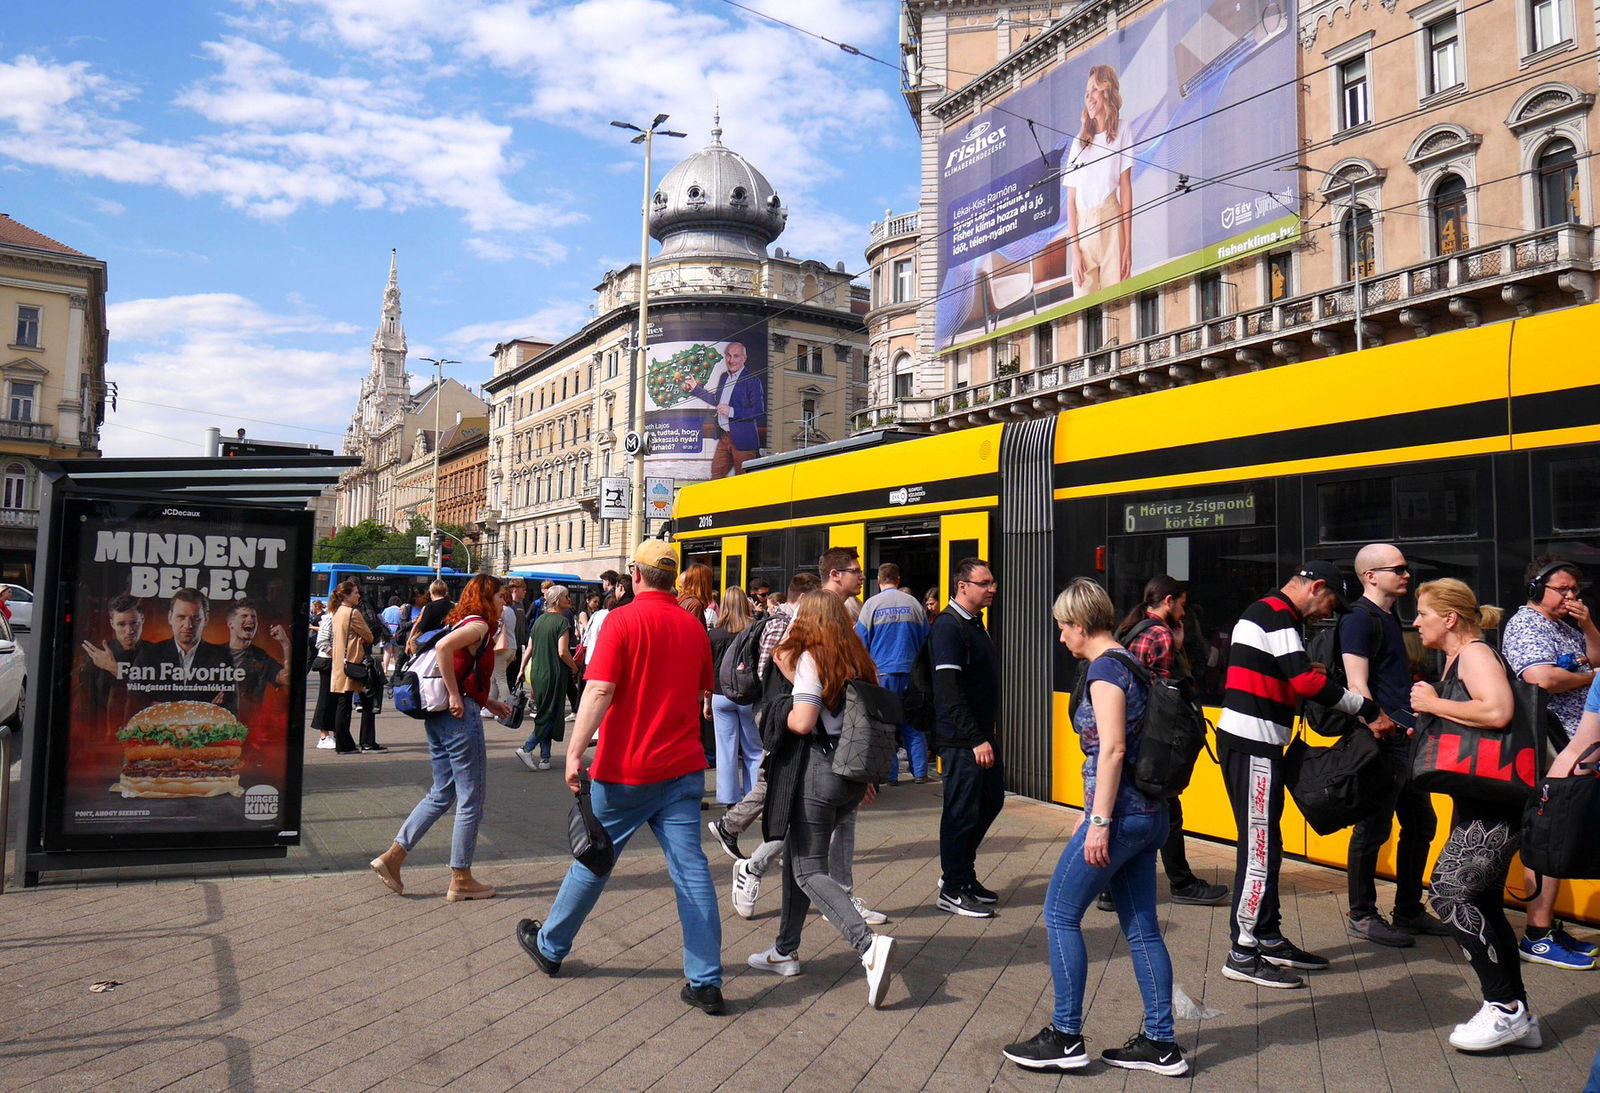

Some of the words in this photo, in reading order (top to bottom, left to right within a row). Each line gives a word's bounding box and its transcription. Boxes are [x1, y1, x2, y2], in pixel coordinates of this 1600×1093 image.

[944, 126, 1007, 170] Fisher
[944, 140, 1007, 179] KLÍMABERENDEZÉSEK
[953, 198, 987, 220] Lékai-Kiss
[987, 183, 1017, 205] Ramóna
[1235, 206, 1242, 216] 6
[1241, 202, 1252, 213] ÉV
[953, 230, 974, 244] Fisher
[996, 207, 1019, 224] hozza
[1020, 201, 1028, 213] el
[1034, 193, 1044, 210] jó
[665, 384, 673, 392] 27
[680, 435, 698, 444] nyári
[681, 429, 700, 437] hogy
[162, 508, 200, 517] JCDecaux
[1140, 504, 1182, 517] Móricz
[1187, 495, 1254, 513] Zsigmond
[698, 515, 713, 528] 2016
[1125, 505, 1136, 533] 6
[1165, 514, 1210, 529] körtér
[1214, 513, 1224, 526] M
[94, 531, 286, 569] MINDENT
[130, 566, 250, 601] BELE!
[116, 661, 156, 681] Fan
[160, 662, 246, 682] Favorite
[126, 683, 172, 693] Válogatott
[172, 683, 235, 692] hozzávalókkal
[245, 795, 279, 804] BURGER
[244, 803, 278, 814] KING
